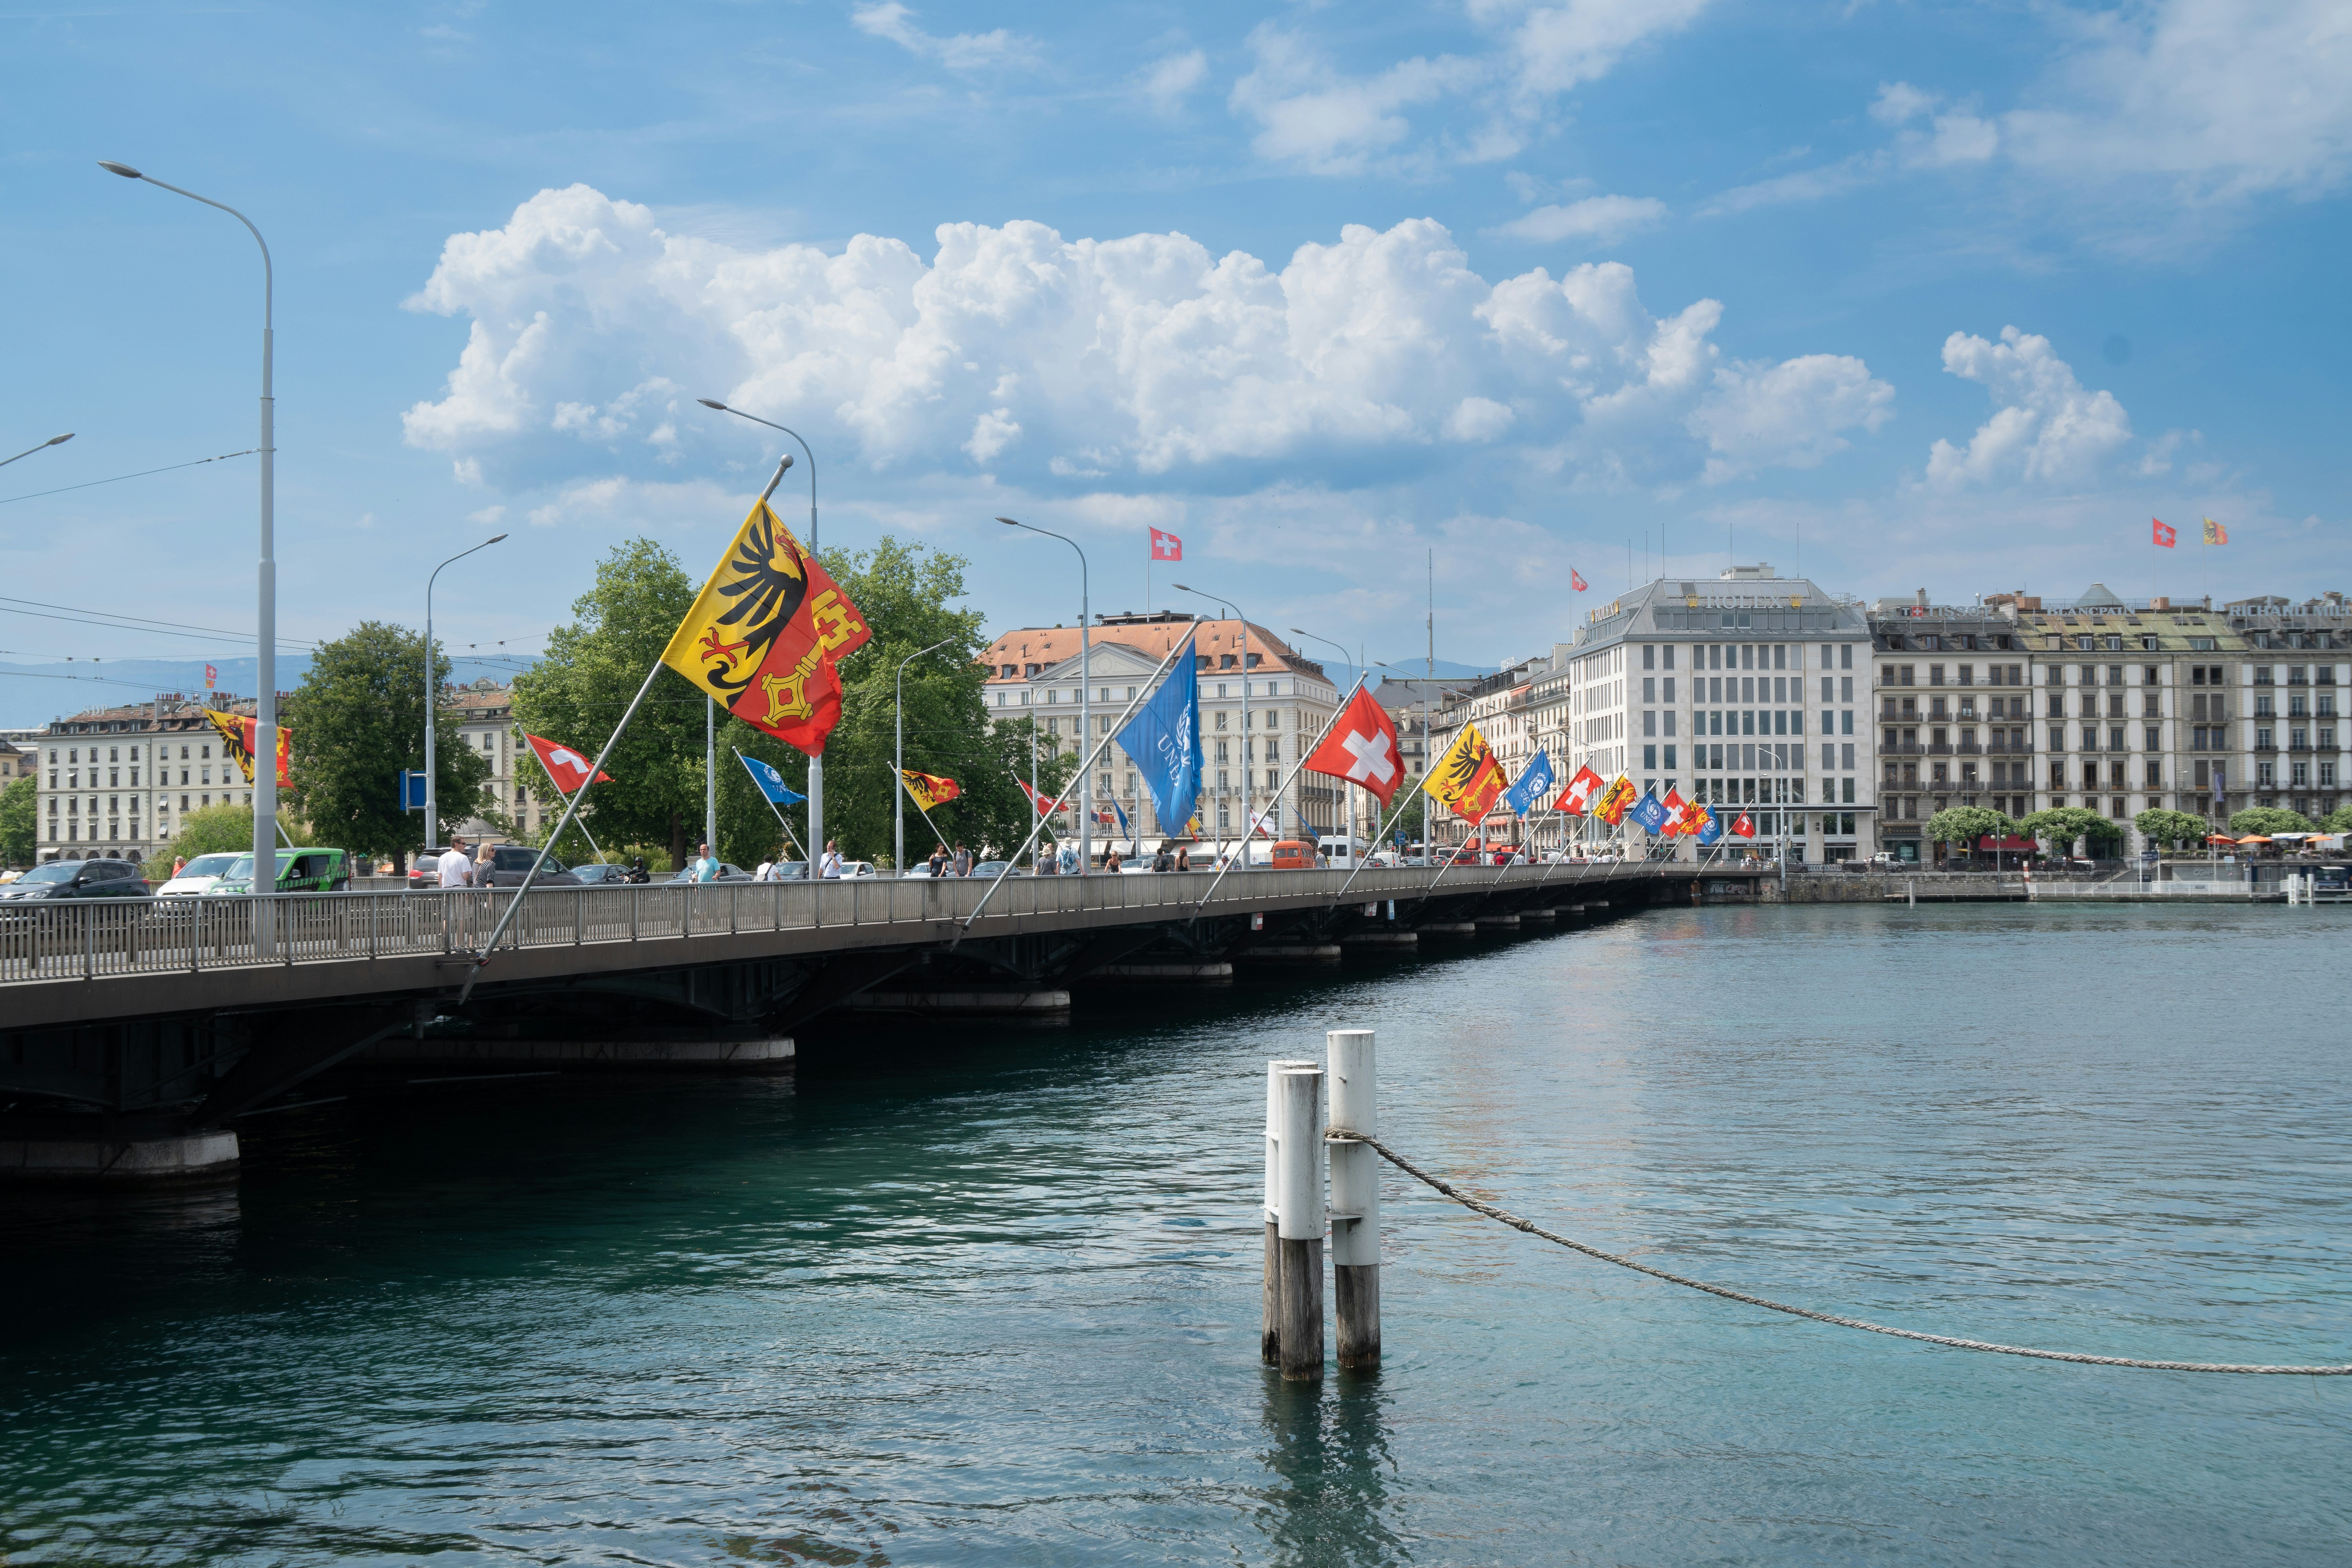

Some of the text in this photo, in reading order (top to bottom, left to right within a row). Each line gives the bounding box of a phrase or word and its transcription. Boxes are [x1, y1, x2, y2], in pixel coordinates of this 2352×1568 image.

[1705, 594, 1784, 609] ROLEX
[1596, 602, 1615, 622] ROLEX
[1925, 606, 1993, 617] TISSOT
[2046, 606, 2135, 616] BLANCPAIN
[2230, 605, 2307, 617] RICHARD
[1501, 656, 1515, 670] BRISTOL
[83, 704, 109, 716] SDP
[175, 698, 250, 713] ZENITH
[1158, 732, 1180, 787] UNE
[1640, 811, 1655, 826] UNEP
